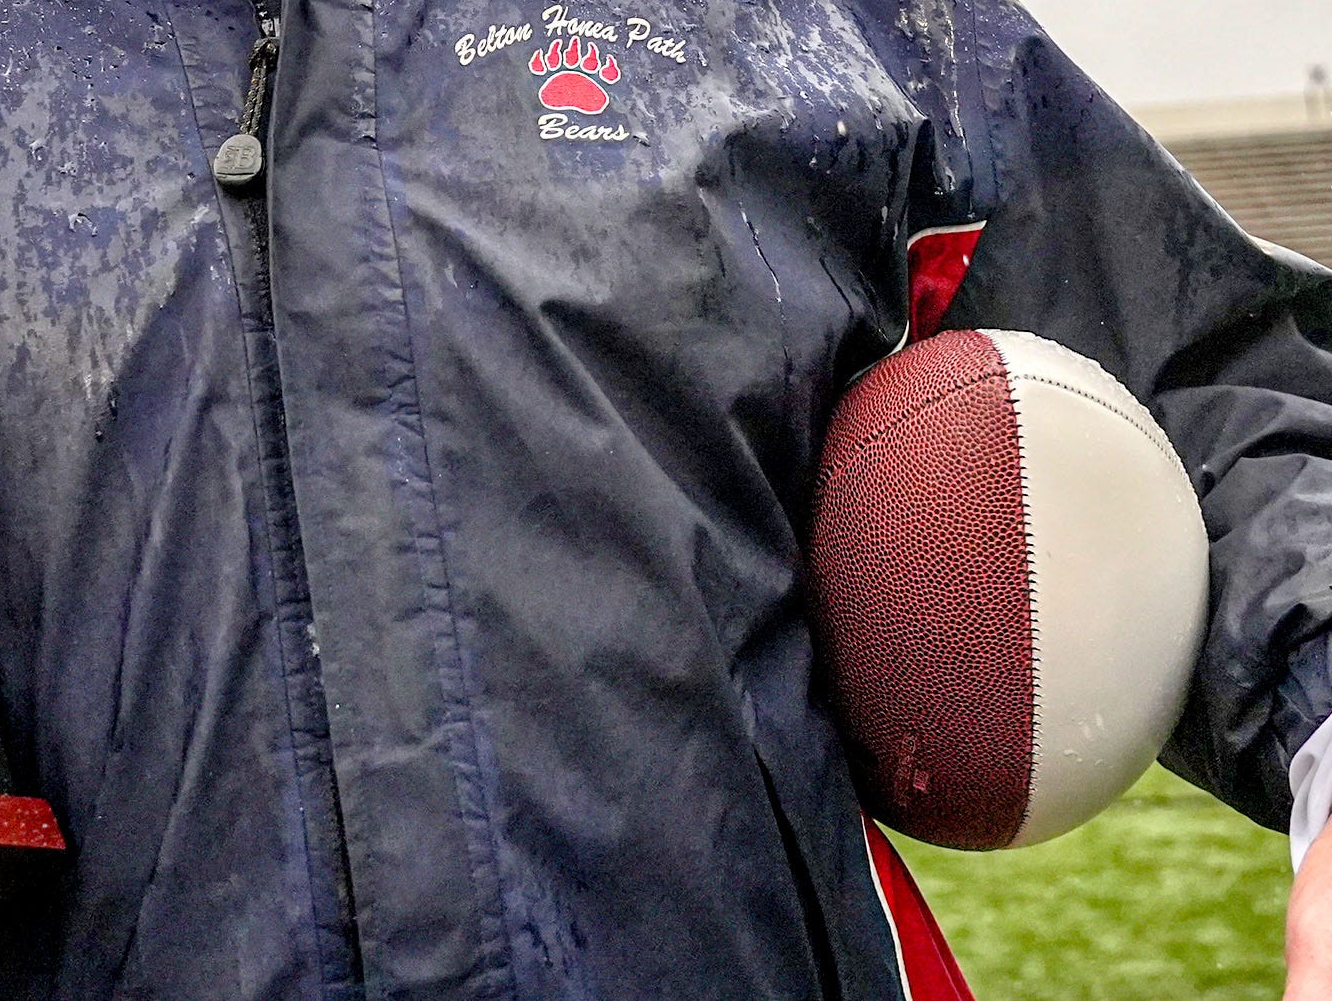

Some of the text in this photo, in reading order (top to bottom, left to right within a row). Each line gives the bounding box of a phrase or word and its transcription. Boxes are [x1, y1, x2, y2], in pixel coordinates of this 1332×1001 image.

[454, 4, 687, 66] Belton Honea Path
[537, 113, 630, 141] Bears
